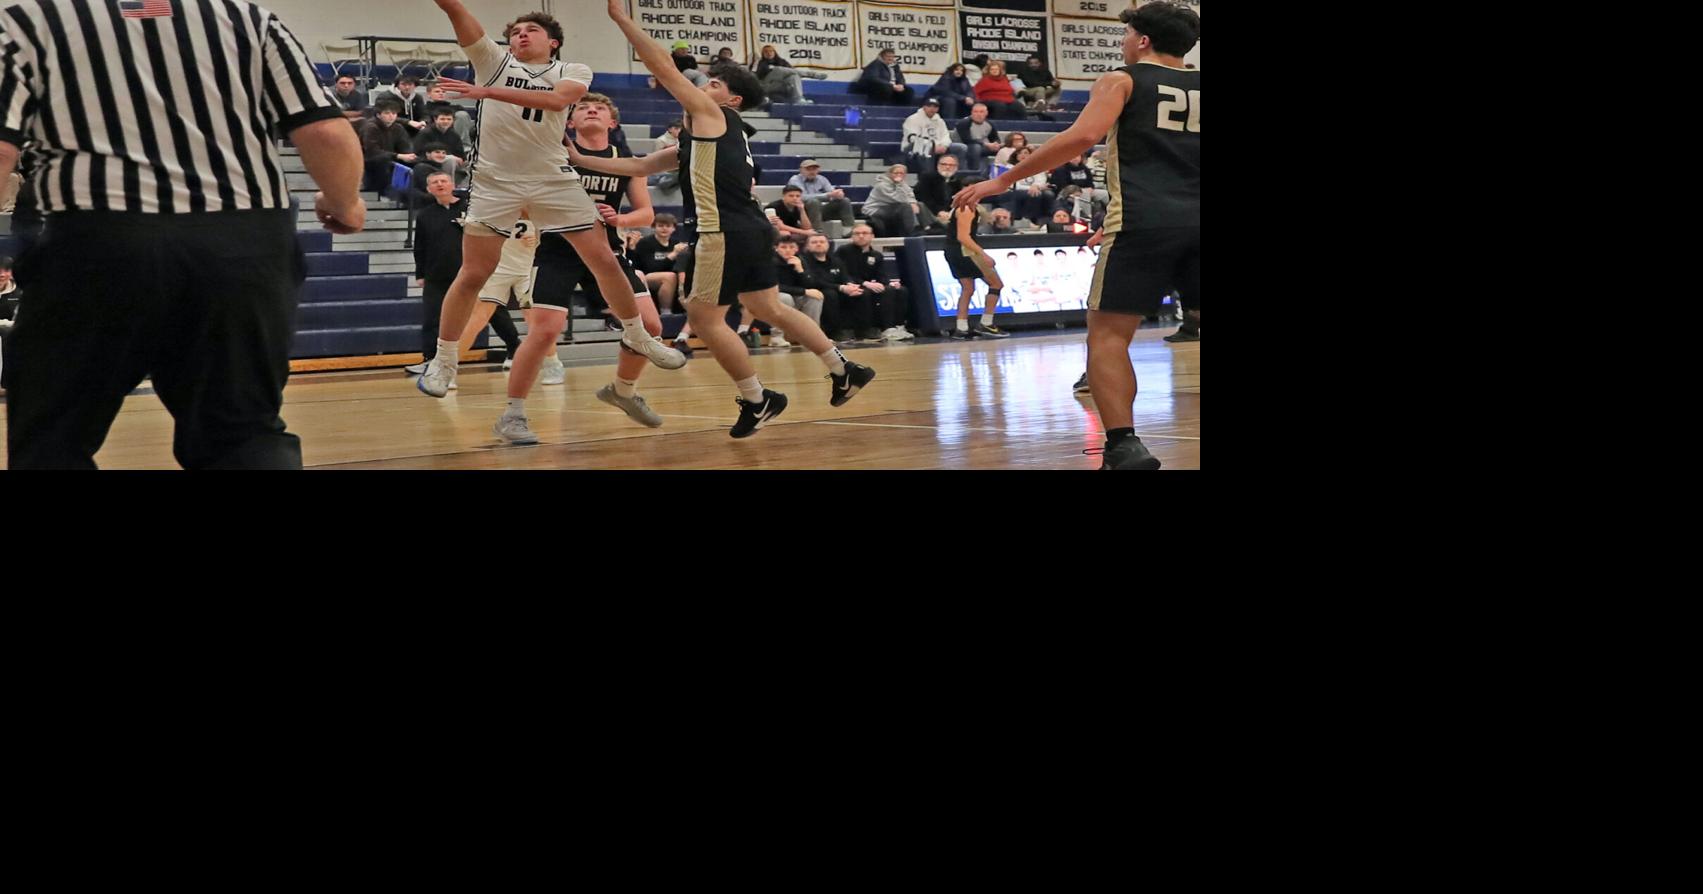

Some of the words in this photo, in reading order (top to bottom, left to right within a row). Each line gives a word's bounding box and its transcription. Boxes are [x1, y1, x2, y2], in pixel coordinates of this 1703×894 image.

[639, 0, 663, 8] GIRLS
[667, 0, 705, 10] OUTDOOR
[709, 2, 736, 12] TRACK
[757, 3, 779, 14] GIRLS
[783, 5, 818, 16] OUTDOOR
[822, 8, 847, 17] TRACK
[641, 13, 685, 24] RHODE
[690, 15, 736, 27] ISLAND
[868, 11, 889, 21] GIRLS
[892, 13, 915, 22] TRACK
[925, 16, 946, 25] FIELD
[966, 15, 992, 26] GIRLS
[994, 17, 1041, 29] LACROSSE
[760, 18, 800, 29] RHODE
[804, 21, 847, 32] ISLAND
[1062, 24, 1085, 33] GIRLS
[1087, 25, 1125, 36] LACROSS
[641, 28, 674, 39] TATE
[678, 30, 738, 41] CHAMPIONS
[868, 25, 905, 36] RHODE
[909, 28, 948, 39] ISLAND
[967, 27, 1002, 38] RHODE
[1004, 29, 1041, 40] ISLAND
[759, 33, 790, 44] STATE
[795, 35, 848, 46] CHAMPIONS
[867, 39, 895, 50] STATE
[898, 41, 949, 52] CHAMPIONS
[1061, 37, 1093, 47] RHODE
[789, 49, 822, 59] 2019
[894, 55, 926, 65] 2017
[1062, 50, 1086, 59] STATE
[580, 174, 619, 192] ORTH
